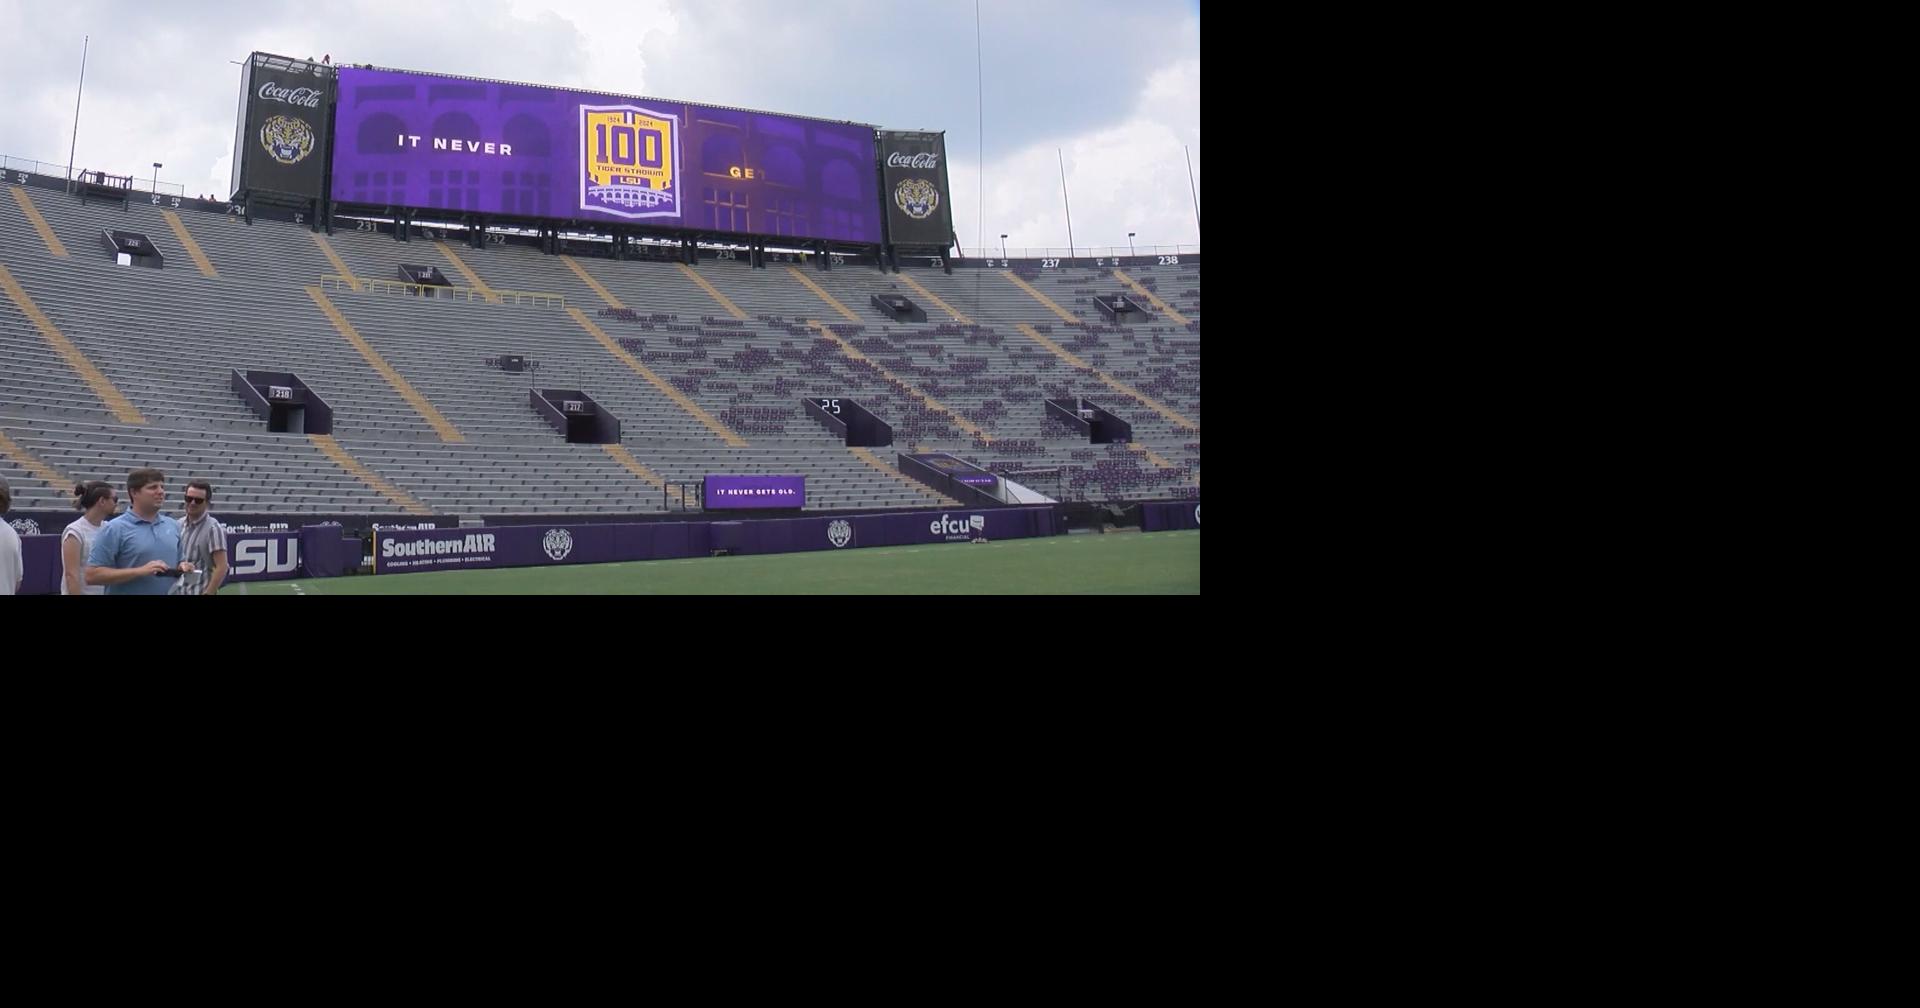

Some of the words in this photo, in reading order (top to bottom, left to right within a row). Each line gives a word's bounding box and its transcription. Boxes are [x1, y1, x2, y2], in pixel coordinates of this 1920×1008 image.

[398, 134, 421, 148] IT
[433, 137, 512, 156] NEVER
[595, 123, 663, 168] 100
[596, 165, 622, 173] TIGER
[624, 168, 664, 177] STADIUM
[620, 176, 641, 185] LSU
[356, 220, 378, 232] 231
[485, 233, 507, 245] 232
[830, 255, 845, 265] 35
[930, 258, 944, 268] 23
[1041, 259, 1060, 268] 237
[1158, 255, 1179, 265] 238
[821, 399, 841, 414] 25
[930, 514, 970, 535] efcu
[229, 538, 298, 575] SU
